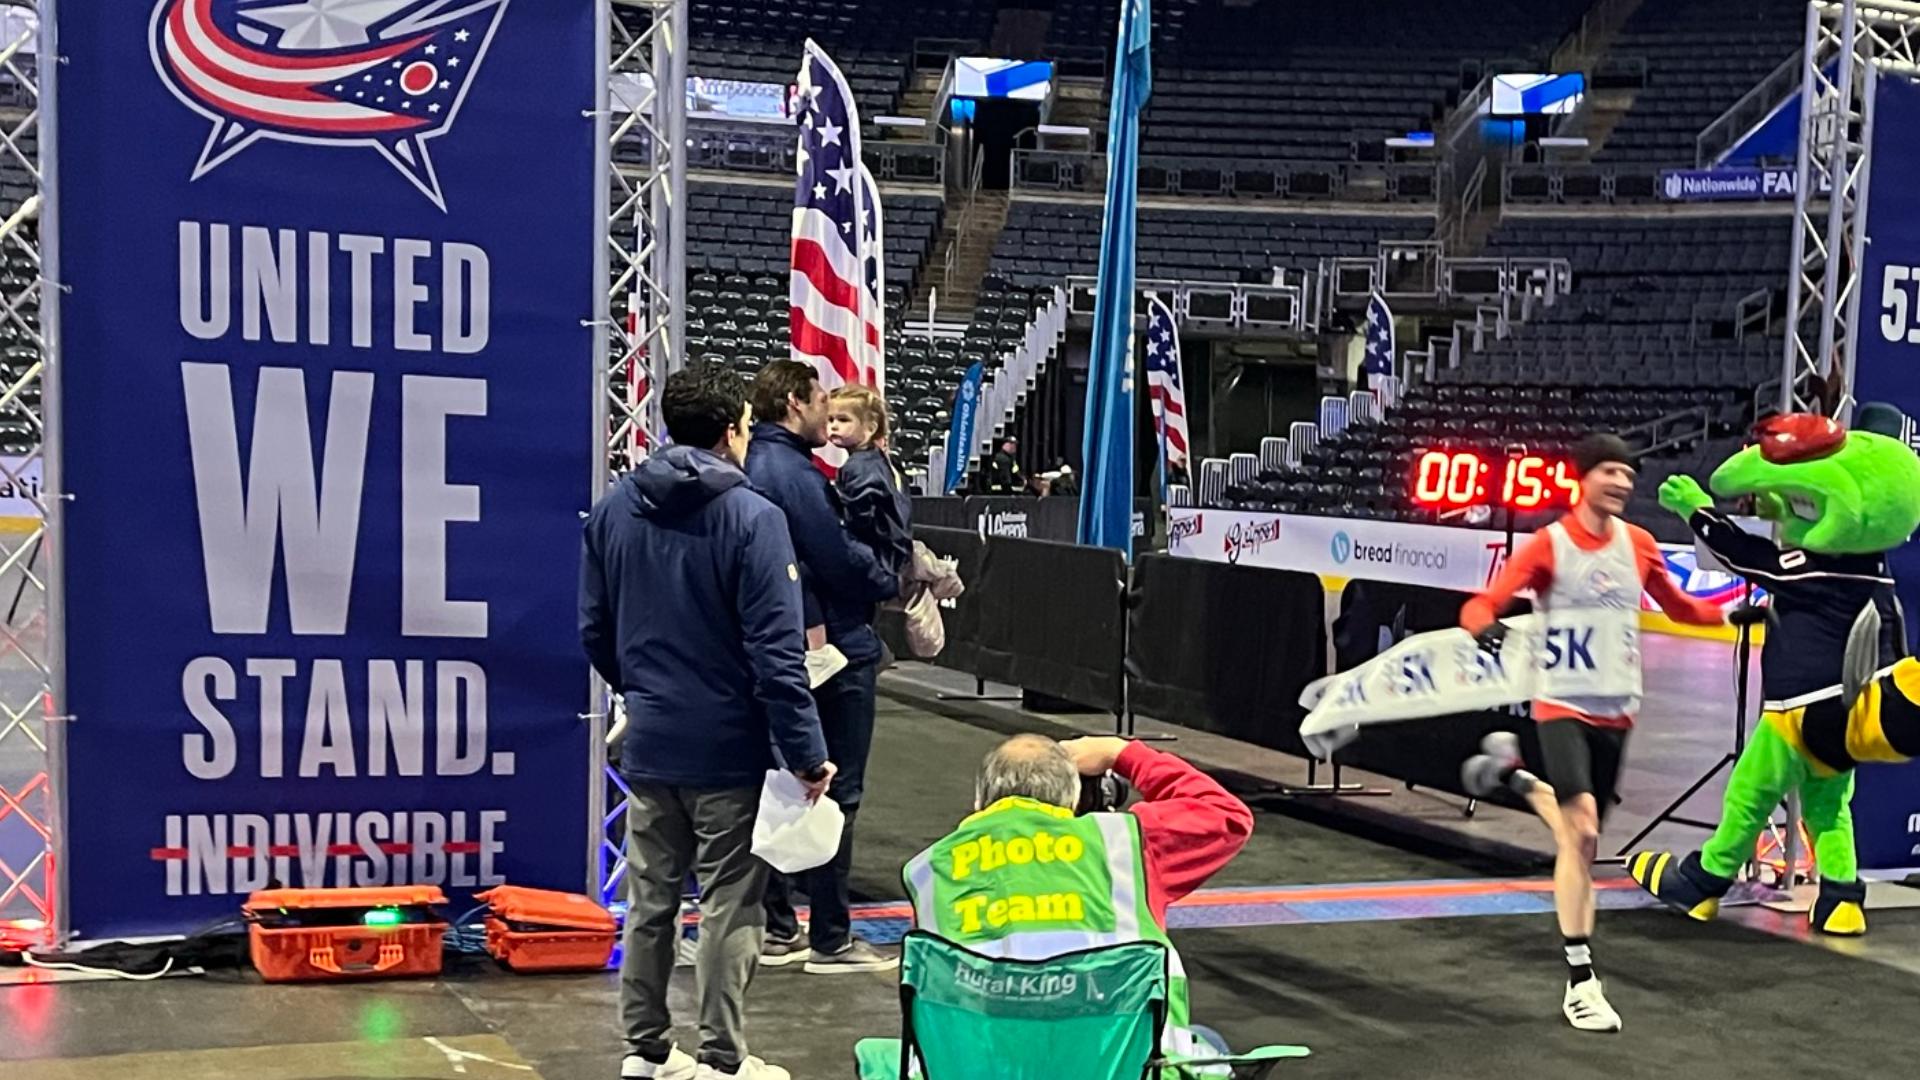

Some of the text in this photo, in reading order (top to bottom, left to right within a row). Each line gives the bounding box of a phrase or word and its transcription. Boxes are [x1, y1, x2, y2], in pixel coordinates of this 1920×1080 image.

[1683, 177, 1757, 193] Nationwide
[179, 220, 490, 354] UNITED
[181, 361, 488, 638] WE
[1416, 451, 1581, 507] 00:15:4
[1354, 540, 1448, 570] bread financial
[1546, 627, 1596, 670] 5K
[182, 656, 515, 780] STAND.
[165, 810, 507, 896] INDIVISIBLE
[952, 831, 1083, 881] Photo
[954, 892, 1085, 934] Team
[955, 962, 1014, 994] Rural
[1020, 972, 1078, 996] King
